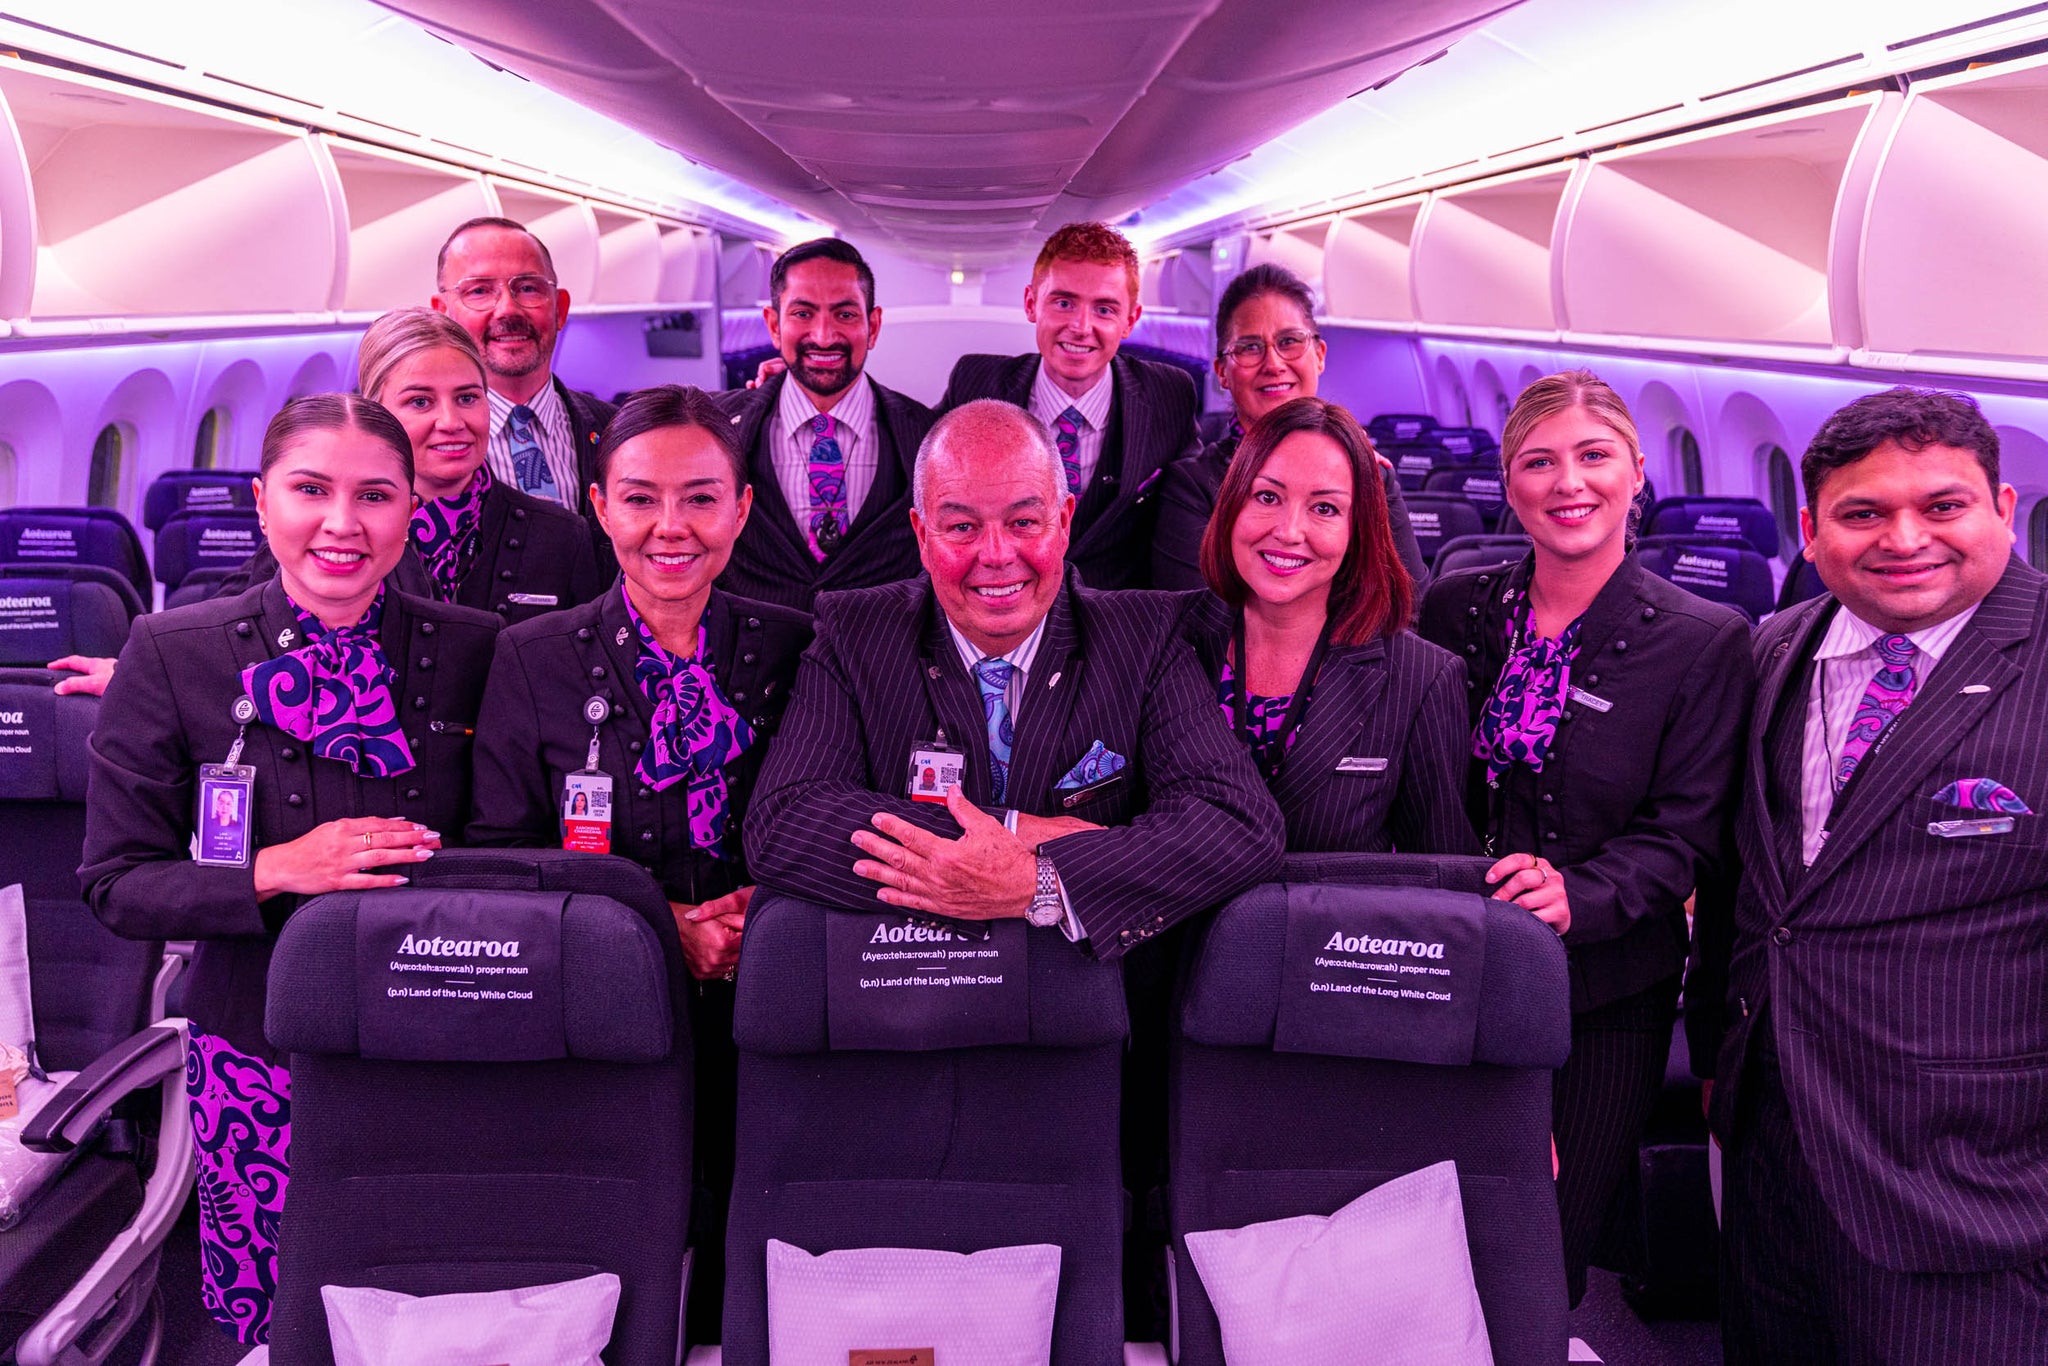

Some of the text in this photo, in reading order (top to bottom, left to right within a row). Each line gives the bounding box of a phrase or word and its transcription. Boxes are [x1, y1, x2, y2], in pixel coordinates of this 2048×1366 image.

[0, 596, 51, 608] otearoa
[397, 934, 520, 957] Aotearoa
[1324, 932, 1444, 959] Aotearoa
[862, 949, 998, 962] (Aye:o:teh:a:row:ah) proper noun
[390, 961, 474, 974] (Aye:o:teh:a:row:ah)
[476, 966, 505, 976] proper
[1315, 957, 1450, 976] (Aye:o:teh:a:row:ah) proper noun
[860, 974, 1002, 989] (p.n) Land of the Long White Cloud
[409, 988, 430, 997] Land
[432, 989, 442, 997] of
[443, 989, 456, 998] the
[458, 989, 479, 1000] Long
[480, 990, 505, 999] White
[507, 990, 533, 1000] Cloud
[1331, 984, 1351, 993] Land
[1353, 985, 1362, 993] of
[1363, 986, 1376, 995] the
[1378, 987, 1399, 998] Long
[1401, 989, 1425, 999] White
[1426, 991, 1451, 1001] Cloud
